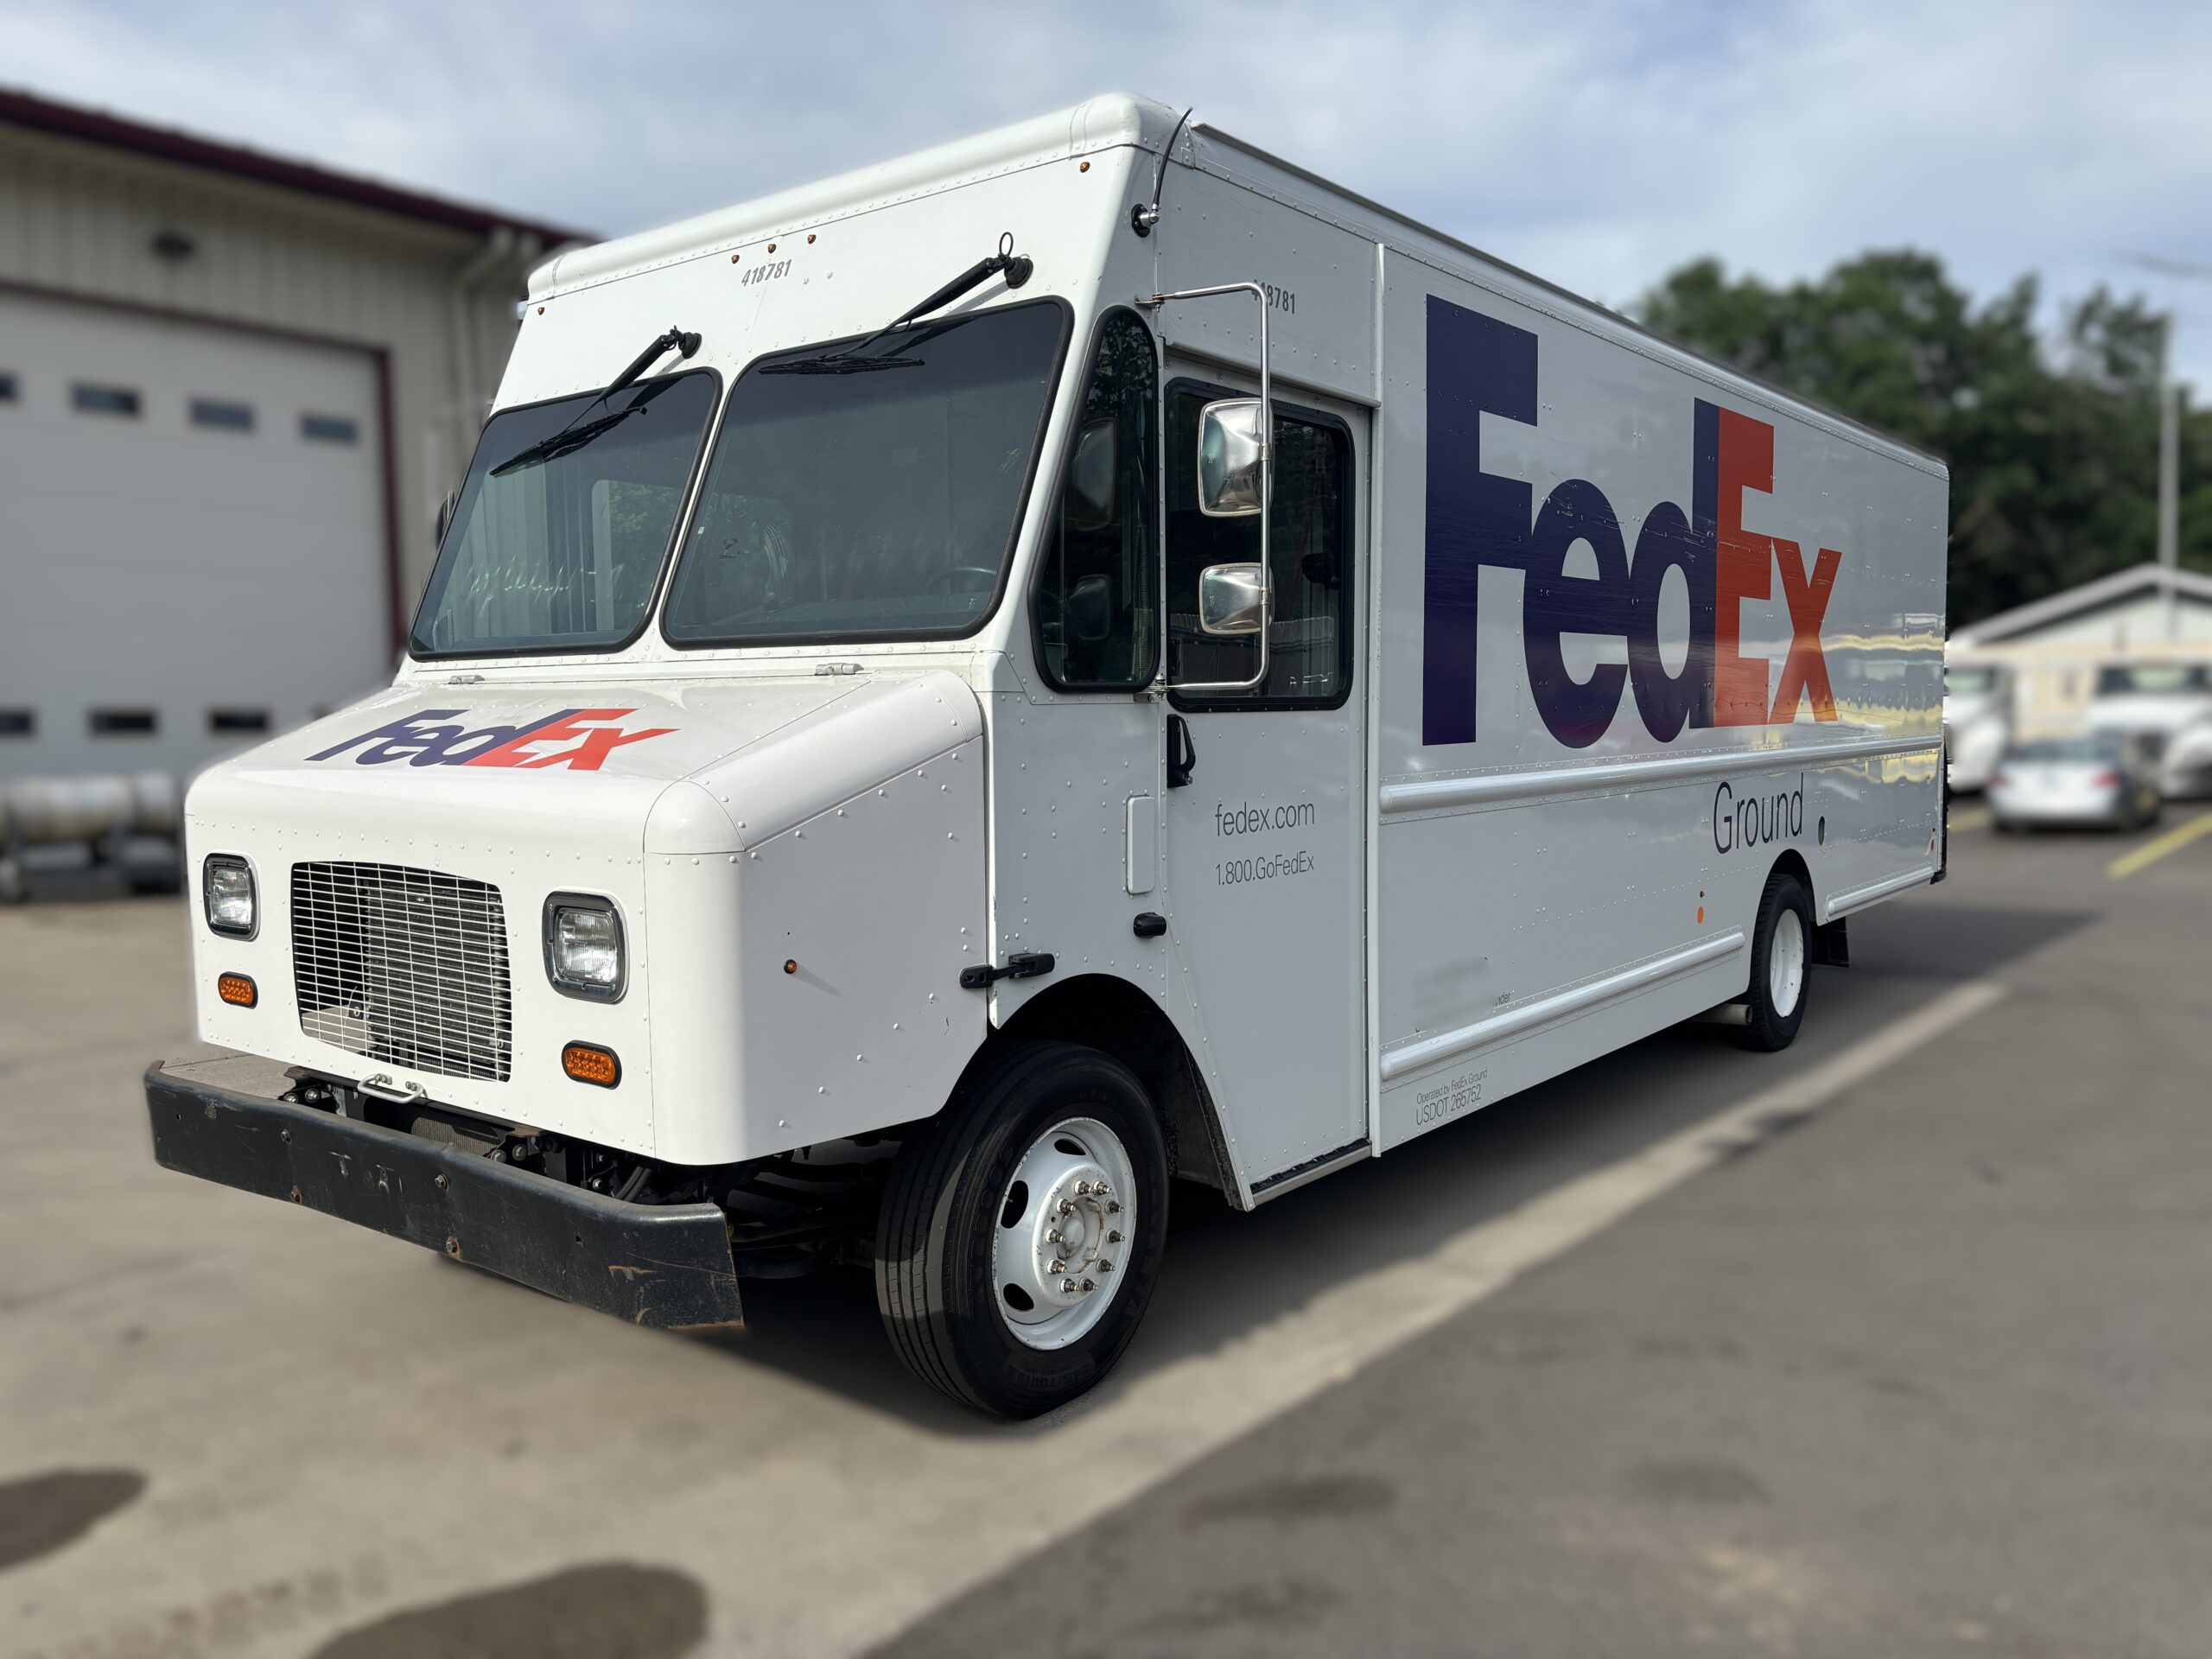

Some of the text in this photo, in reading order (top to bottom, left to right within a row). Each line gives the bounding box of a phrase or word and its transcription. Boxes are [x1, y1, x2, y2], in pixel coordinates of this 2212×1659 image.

[741, 259, 792, 286] 418781
[1422, 293, 1842, 748] FedEx
[303, 709, 682, 771] FedEx
[1215, 802, 1314, 836] fedex.com
[1713, 772, 1804, 854] Ground
[1215, 851, 1314, 886] 1.800.GoFedEx
[1416, 1084, 1481, 1125] USDOT 265752
[1417, 1067, 1488, 1105] Operated by FedEx Ground
